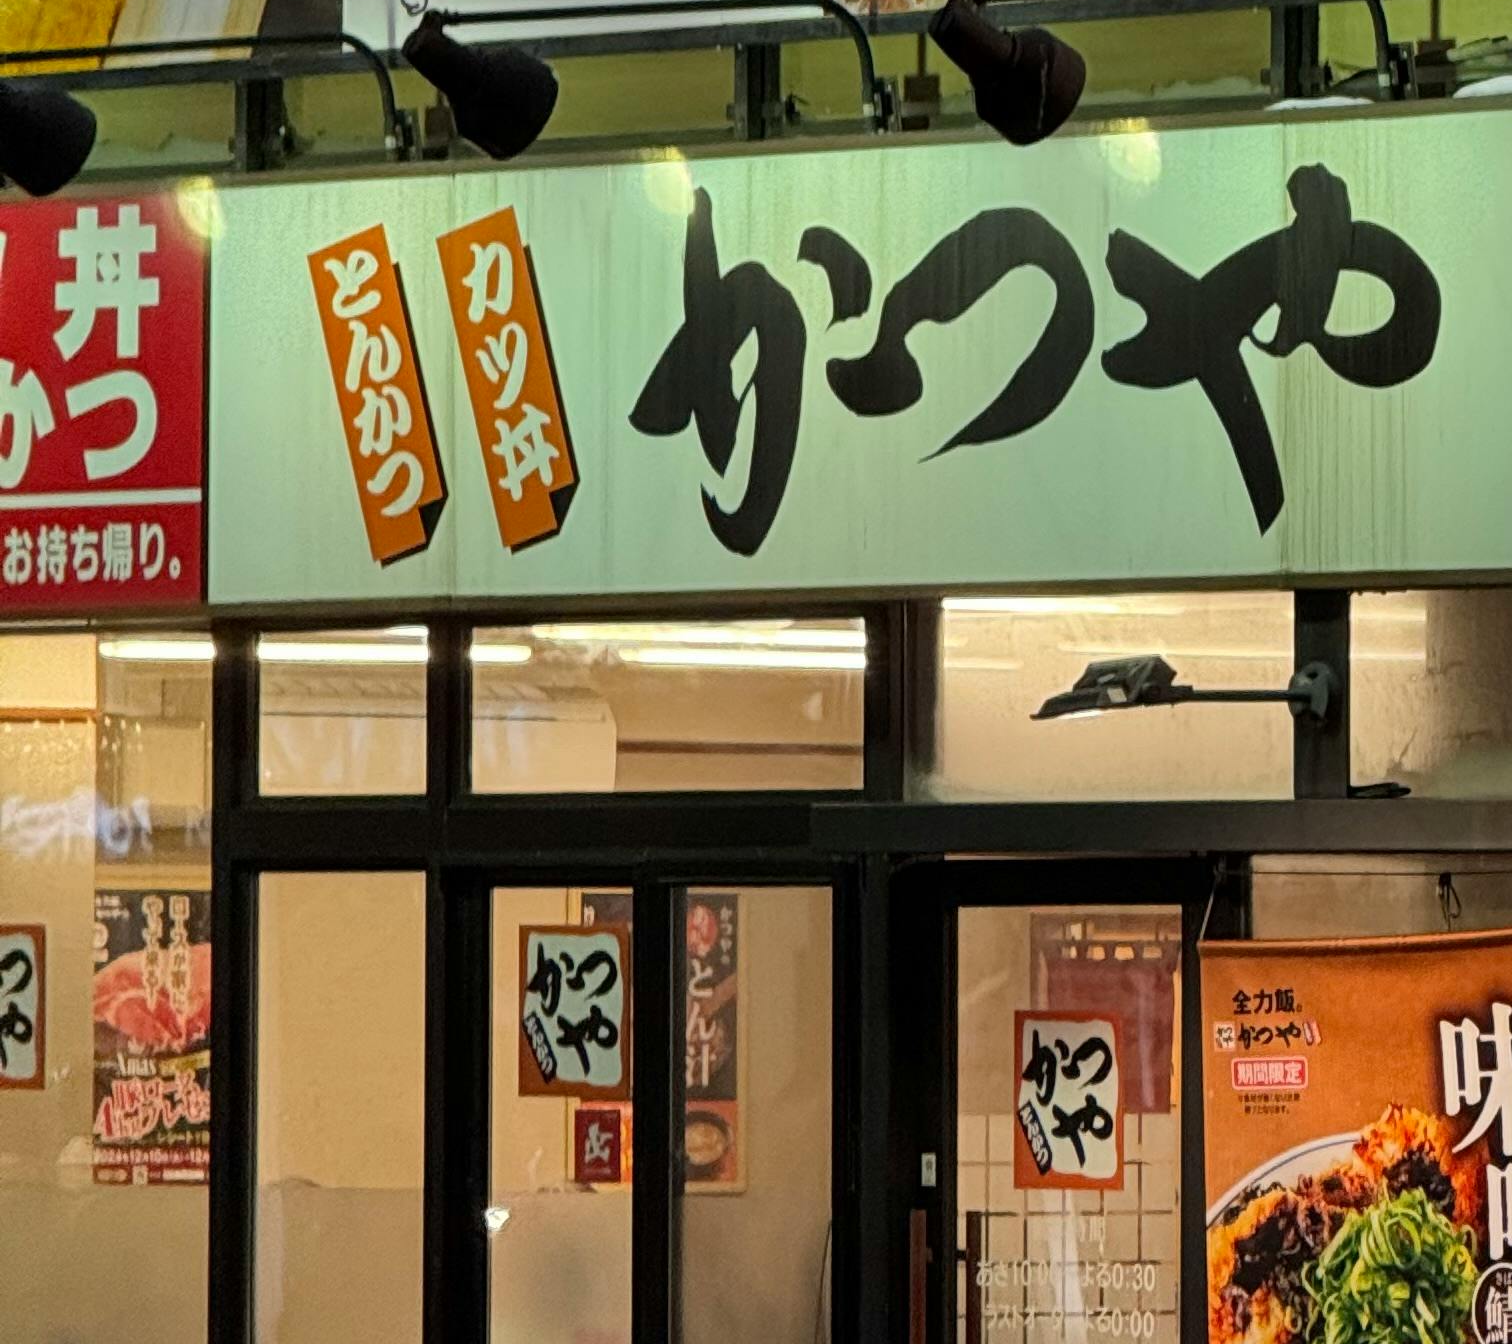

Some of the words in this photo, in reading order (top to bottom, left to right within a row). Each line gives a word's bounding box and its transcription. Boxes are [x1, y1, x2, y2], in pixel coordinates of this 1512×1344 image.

[323, 249, 423, 517] とんかつ
[463, 241, 560, 502] カツ丼
[628, 162, 1441, 557] かつや
[3, 522, 181, 587] お持ち帰り。
[527, 942, 619, 1077] かつや
[1236, 1061, 1303, 1086] 期間限定
[1238, 1021, 1302, 1050] かつや
[1022, 1029, 1113, 1168] かつや
